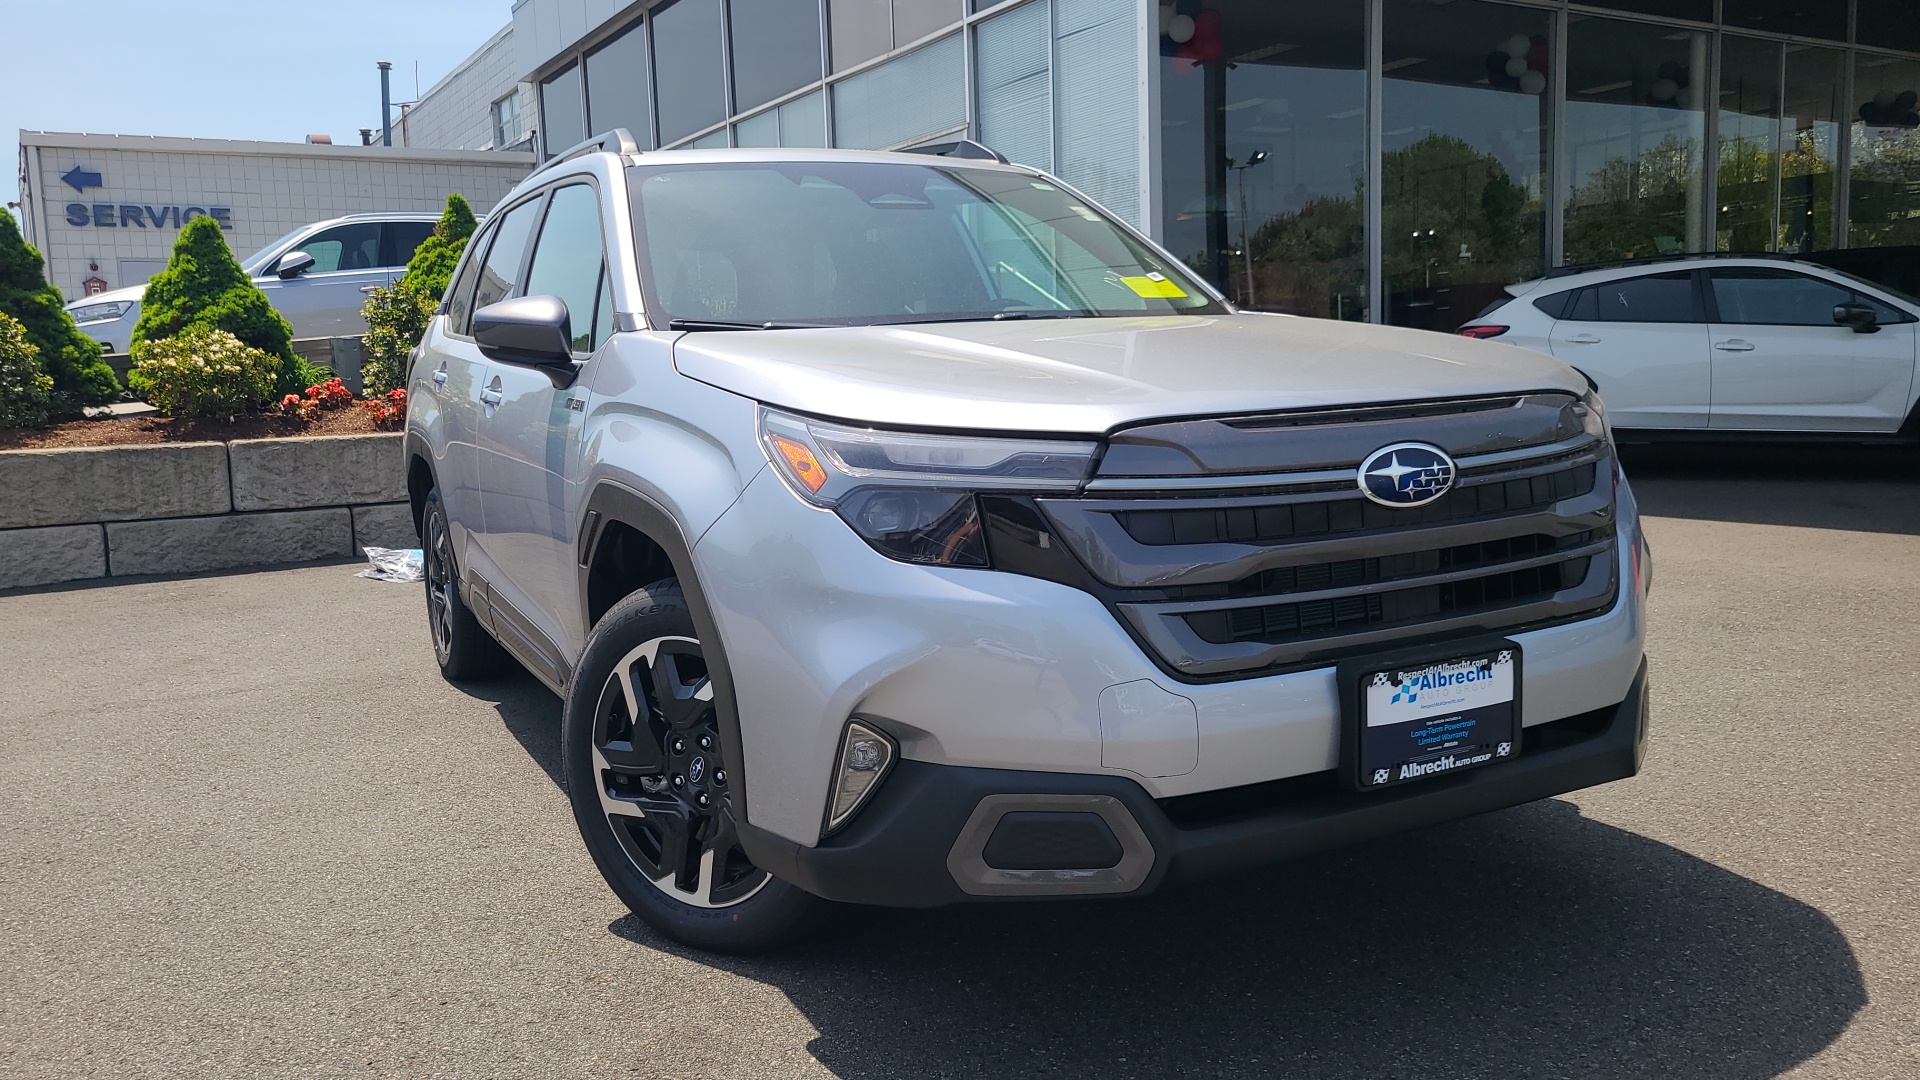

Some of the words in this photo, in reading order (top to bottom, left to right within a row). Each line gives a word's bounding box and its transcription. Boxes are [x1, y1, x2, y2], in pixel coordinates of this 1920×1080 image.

[66, 203, 233, 230] SERVICE
[1397, 658, 1488, 681] RespectAtAlbrecht.com
[1420, 665, 1492, 691] Albrecht
[1420, 689, 1449, 701] AUTO
[1455, 680, 1494, 695] GROUP
[1410, 726, 1443, 738] Long-Term
[1444, 719, 1476, 731] Powertrain
[1418, 735, 1441, 746] Limited
[1442, 730, 1469, 741] Warranty
[1399, 754, 1455, 779] Albrecht
[1455, 758, 1471, 768] AUTO
[1471, 753, 1492, 764] GROUP
